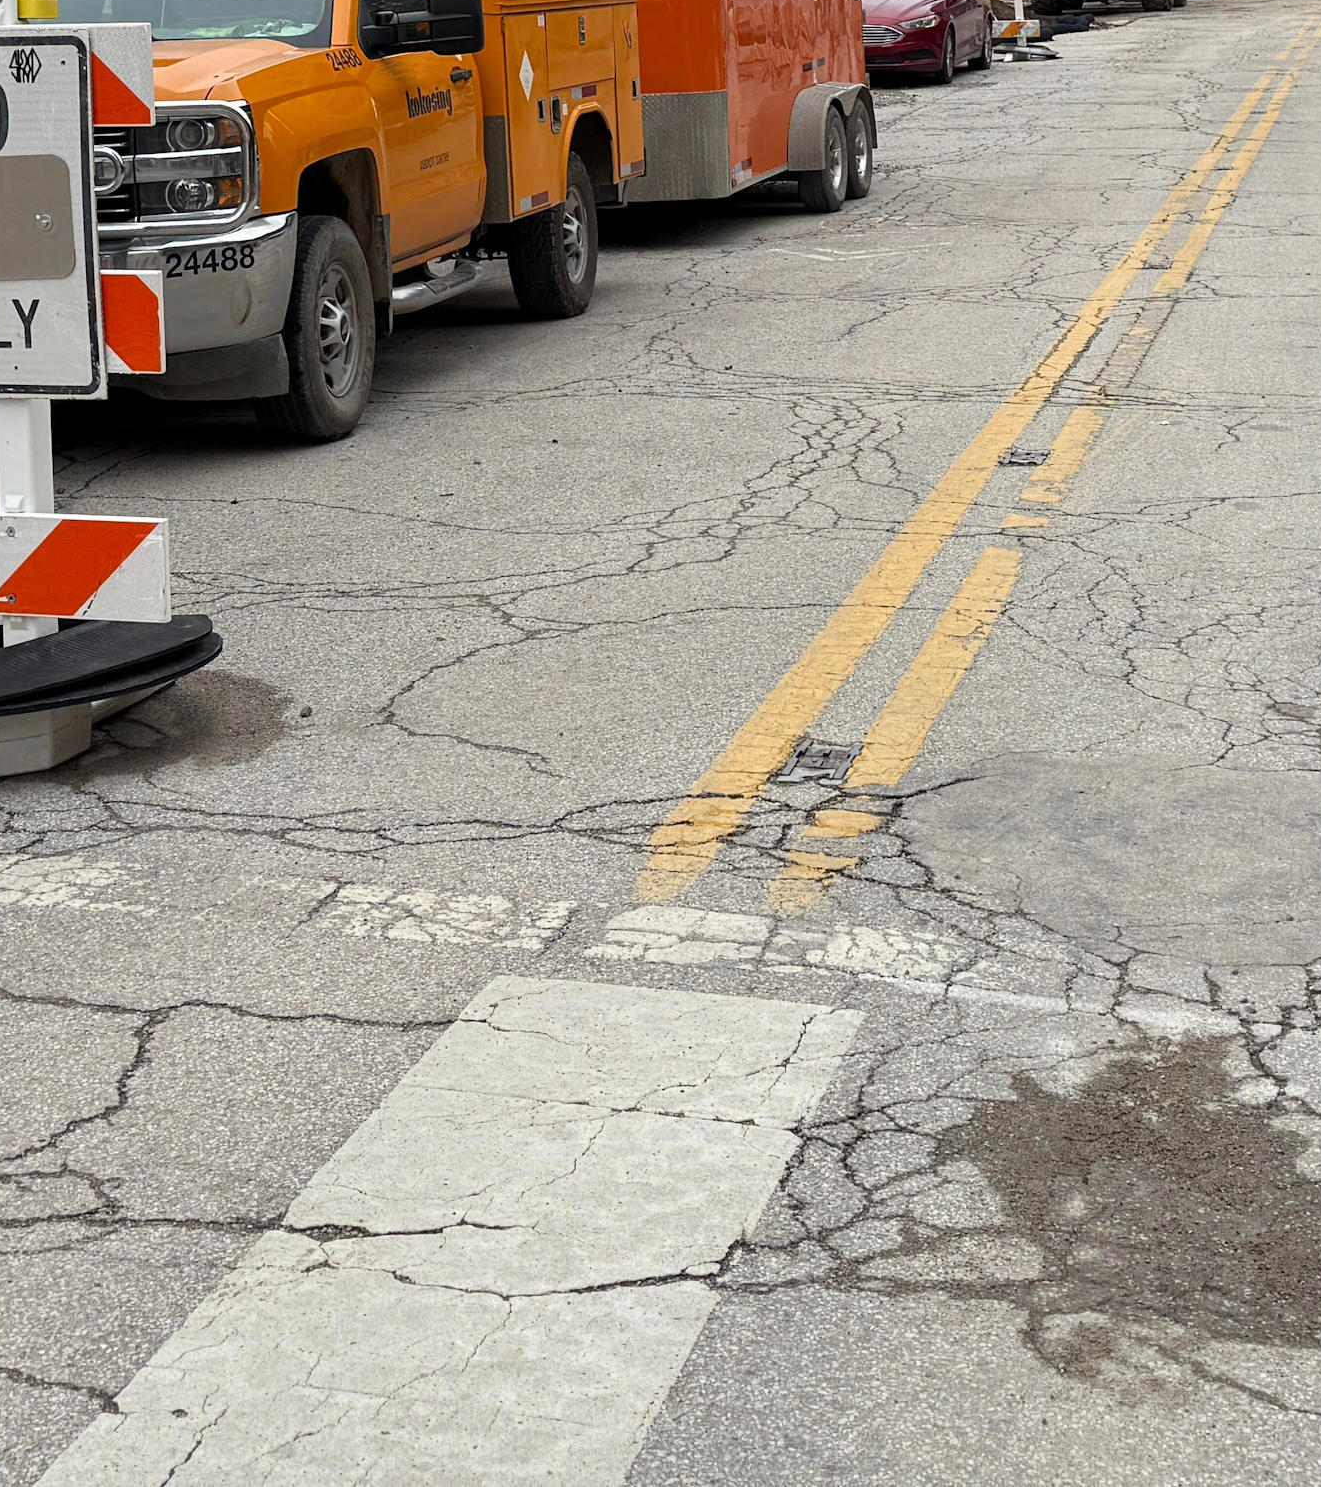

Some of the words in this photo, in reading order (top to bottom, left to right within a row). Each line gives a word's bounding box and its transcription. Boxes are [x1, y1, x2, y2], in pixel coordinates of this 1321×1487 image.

[326, 48, 363, 71] 24488
[405, 87, 453, 119] kokosing
[165, 244, 255, 279] 24488
